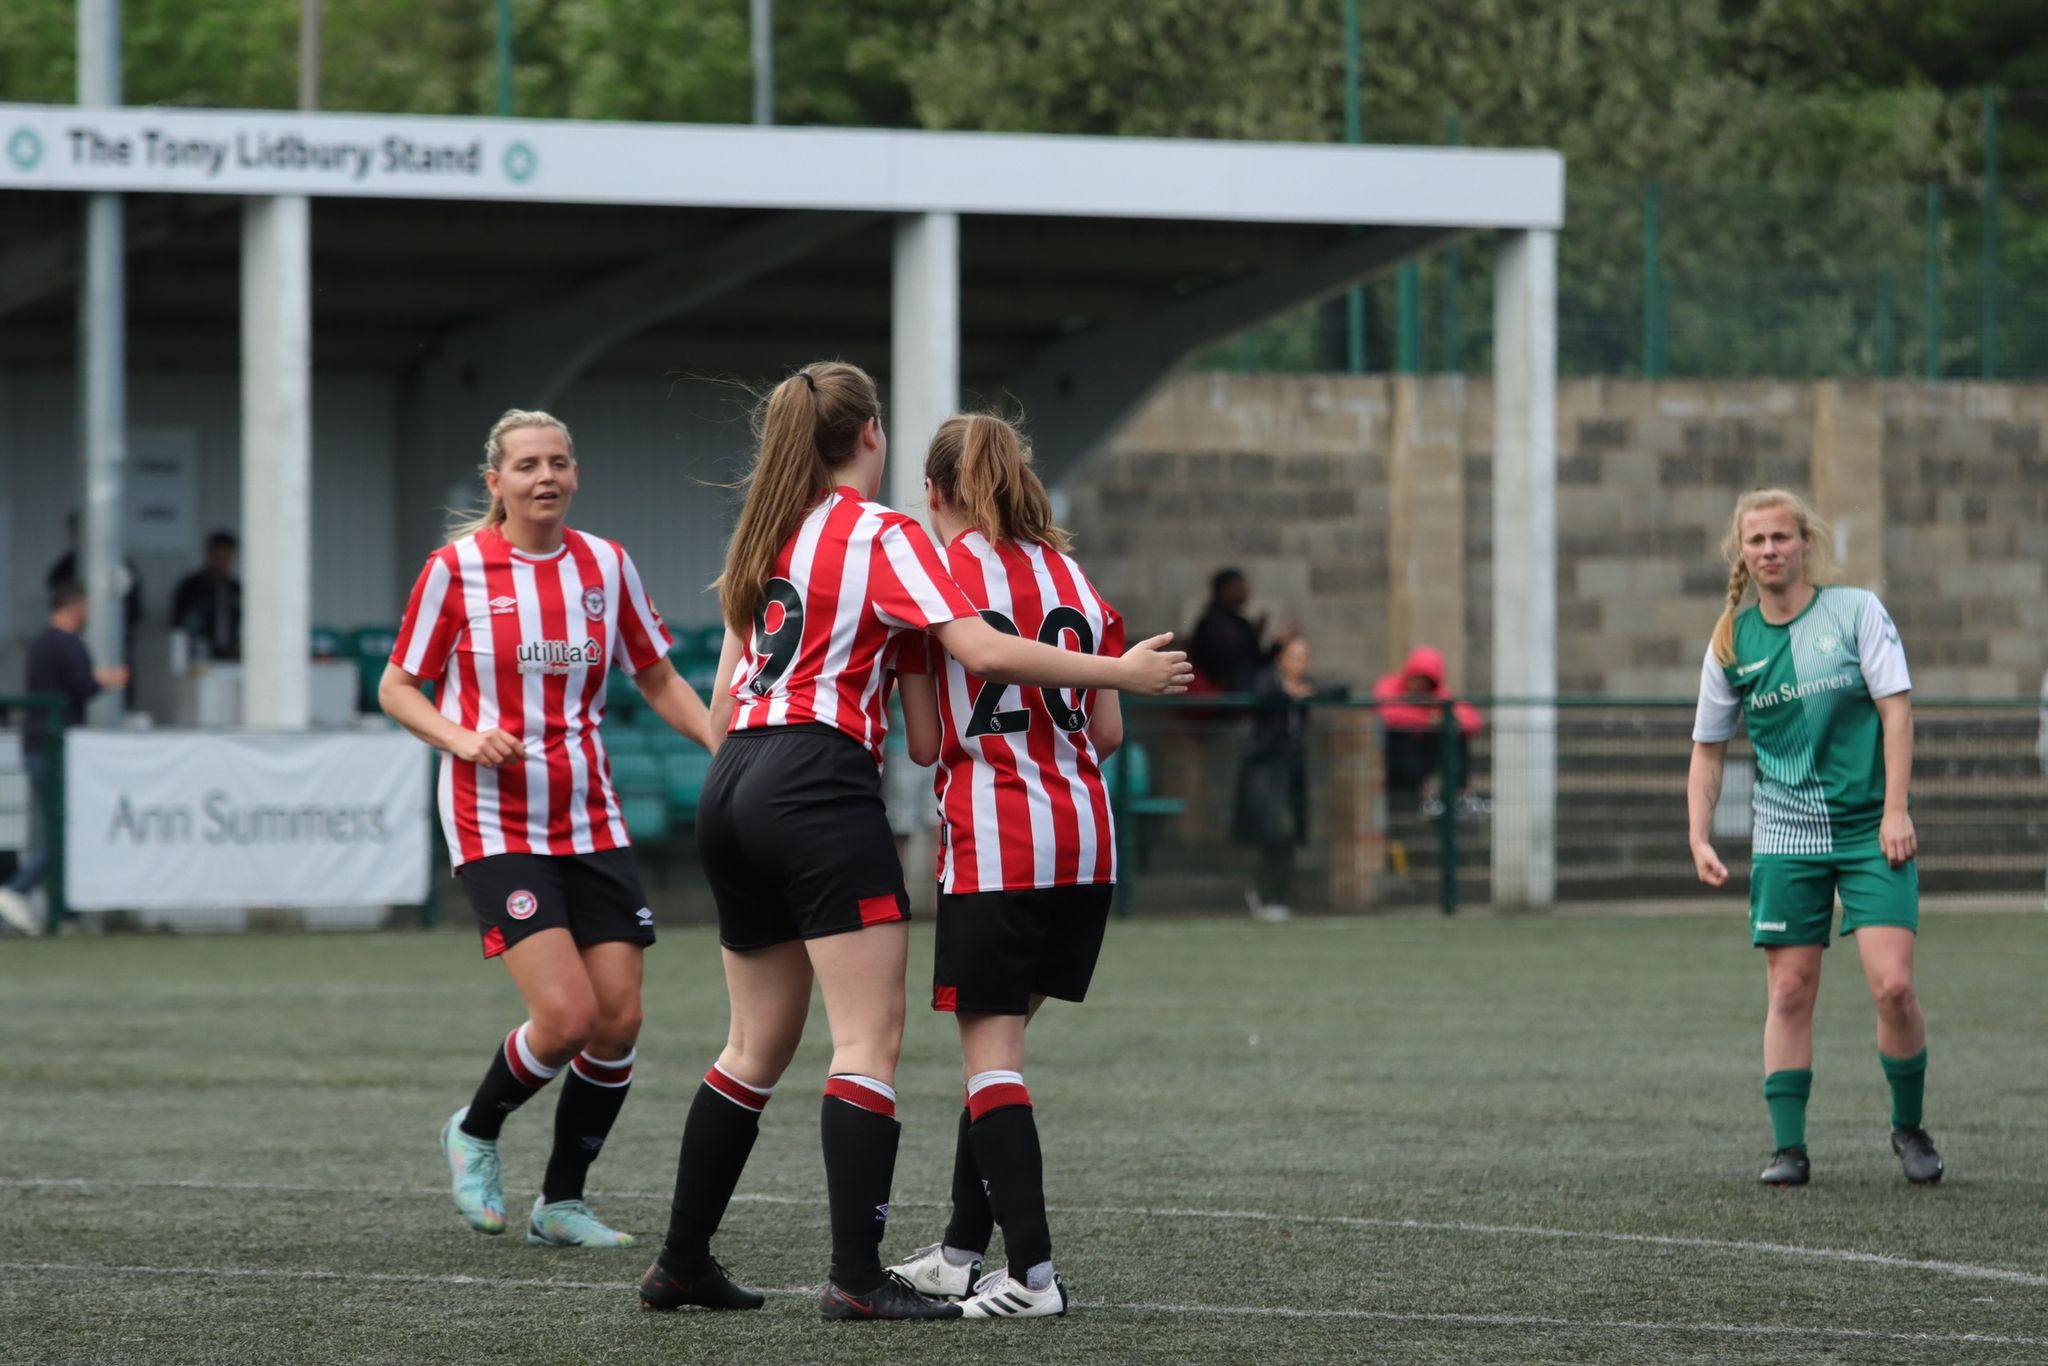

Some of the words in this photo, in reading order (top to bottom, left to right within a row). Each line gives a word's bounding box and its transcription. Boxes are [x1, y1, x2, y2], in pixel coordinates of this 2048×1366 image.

[68, 129, 131, 166] The
[142, 131, 229, 178] Tony
[236, 134, 373, 179] Lidbury
[379, 138, 483, 176] Stand
[518, 641, 582, 663] utilita
[749, 577, 805, 697] 9
[950, 605, 1095, 738] 20
[1751, 691, 1779, 711] Ann
[1780, 672, 1853, 702] Summers
[107, 795, 191, 846] Ann
[202, 789, 392, 846] Summers
